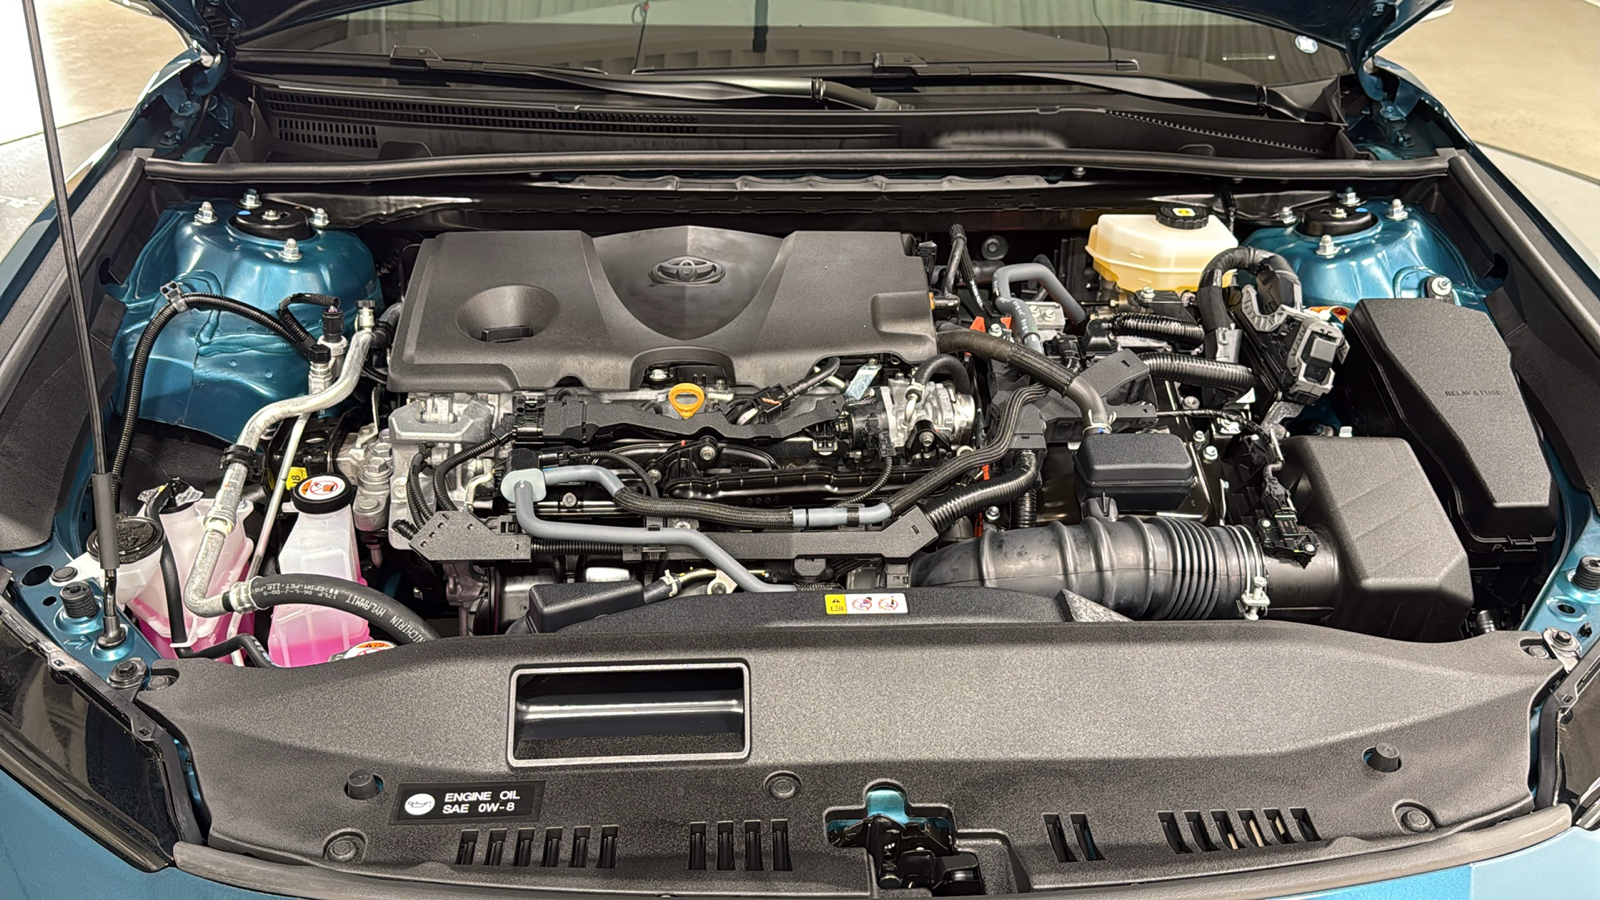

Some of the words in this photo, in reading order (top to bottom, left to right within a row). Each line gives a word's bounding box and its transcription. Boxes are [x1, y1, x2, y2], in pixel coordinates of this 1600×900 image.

[389, 615, 426, 643] NICHIRIN
[444, 791, 493, 802] ENGINE
[499, 790, 521, 800] OIL
[442, 803, 470, 814] SAE
[478, 802, 515, 813] 0W-8
